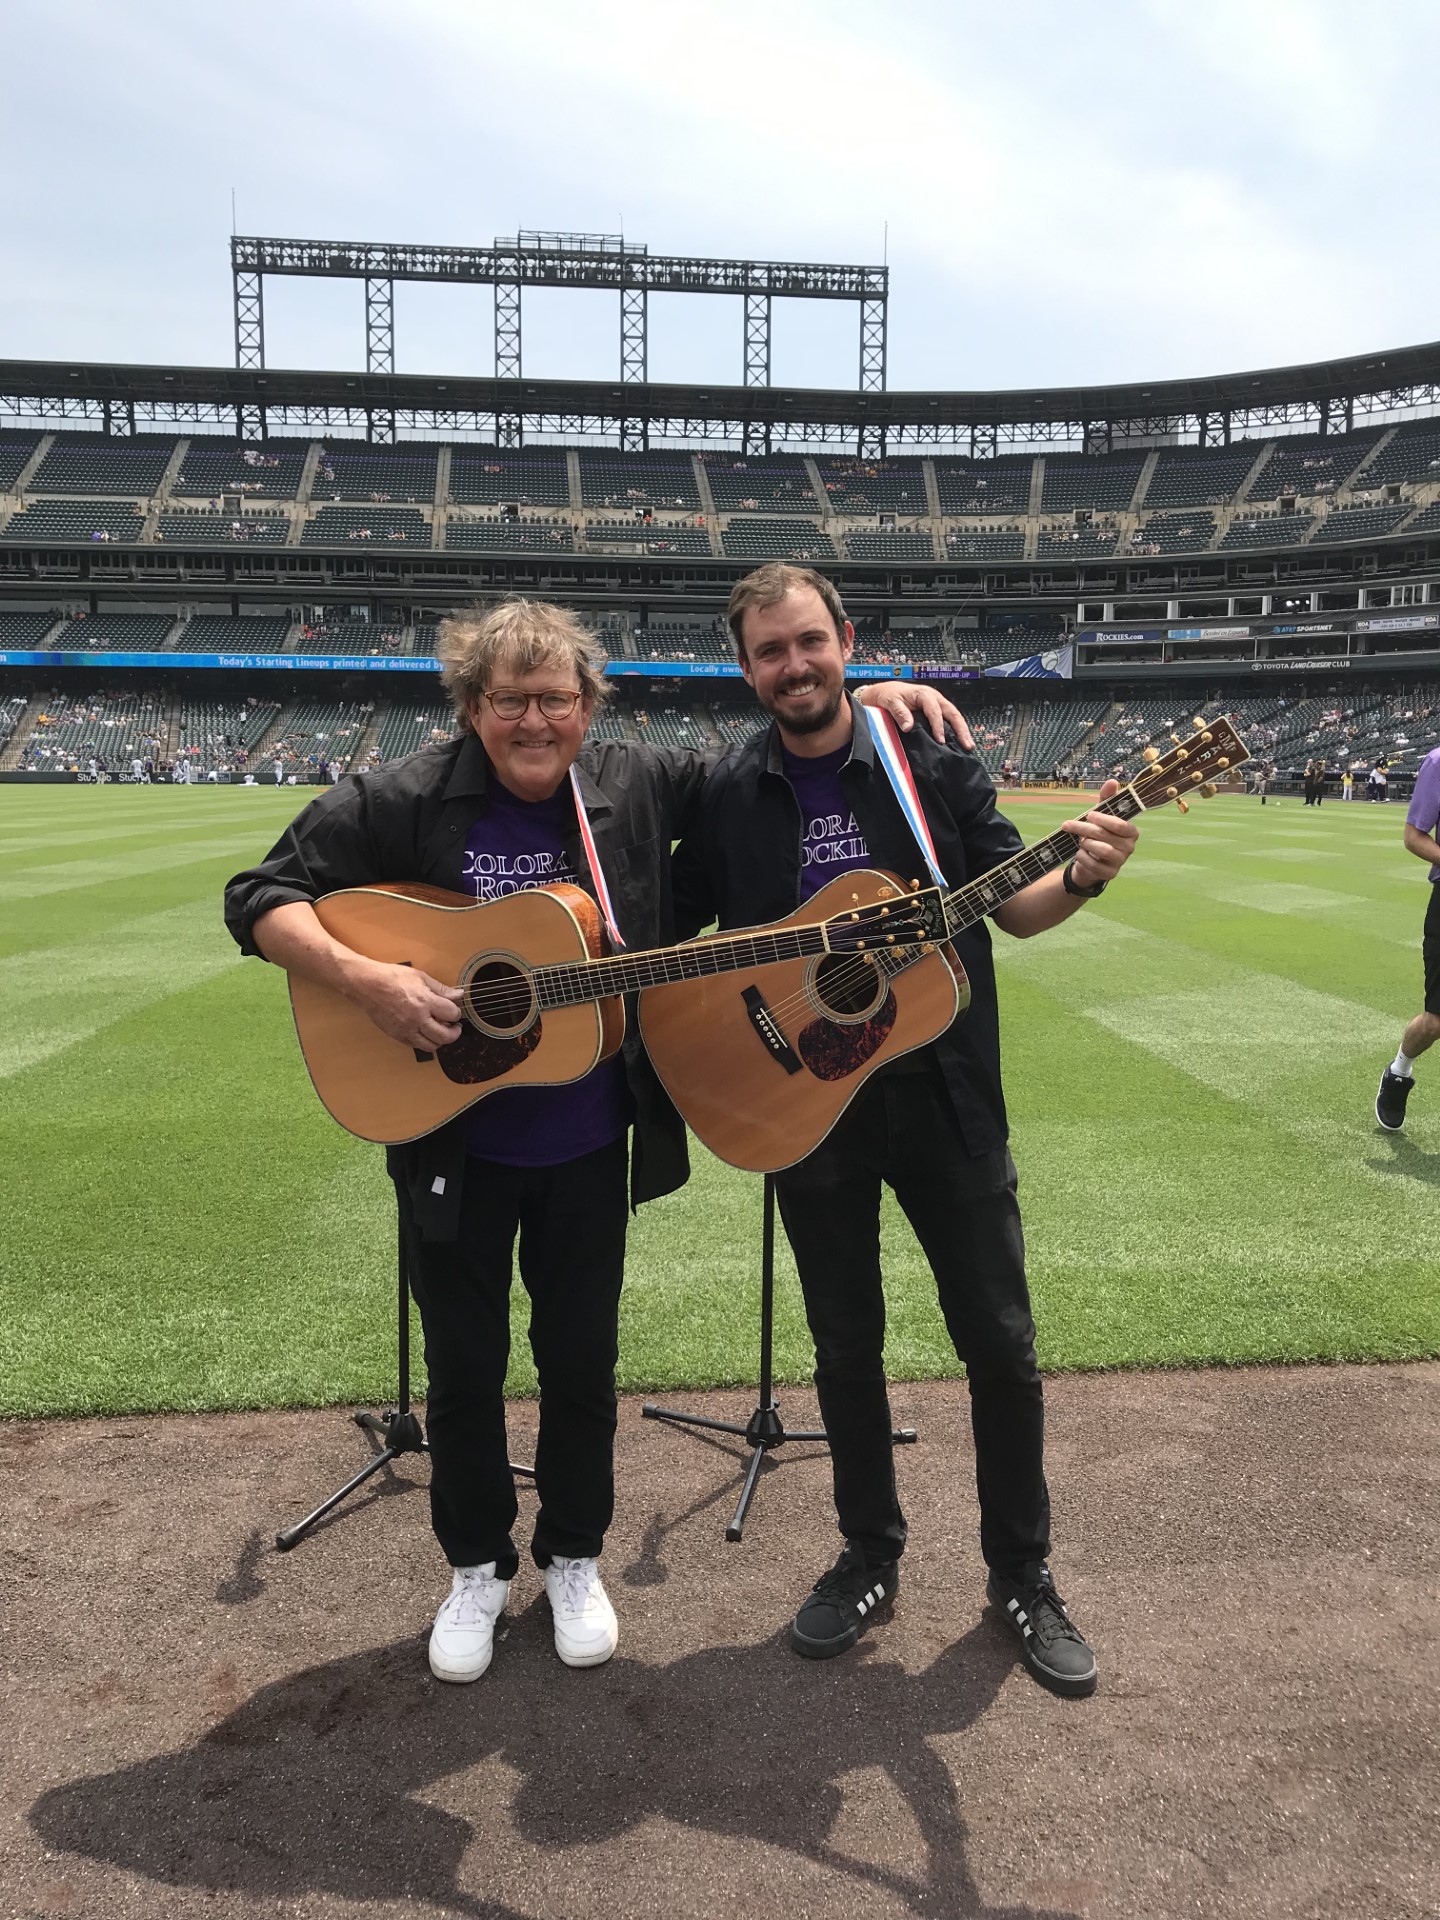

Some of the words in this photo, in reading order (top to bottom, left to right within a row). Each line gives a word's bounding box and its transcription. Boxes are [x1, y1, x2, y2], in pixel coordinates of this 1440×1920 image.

[1296, 624, 1333, 632] SPORTSNET
[1096, 632, 1144, 642] ROCKIES.com
[218, 656, 252, 667] Today's
[255, 657, 293, 669] Starting
[296, 657, 330, 669] Lineups
[333, 658, 367, 669] printed
[369, 658, 386, 669] and
[389, 659, 431, 669] delivered
[433, 659, 444, 671] by
[1290, 661, 1306, 669] LAND
[1306, 661, 1332, 669] CRUISER
[1331, 660, 1351, 668] CLUB
[690, 664, 719, 675] Locally
[845, 669, 859, 677] The
[859, 669, 872, 677] UPS
[872, 669, 891, 677] Store
